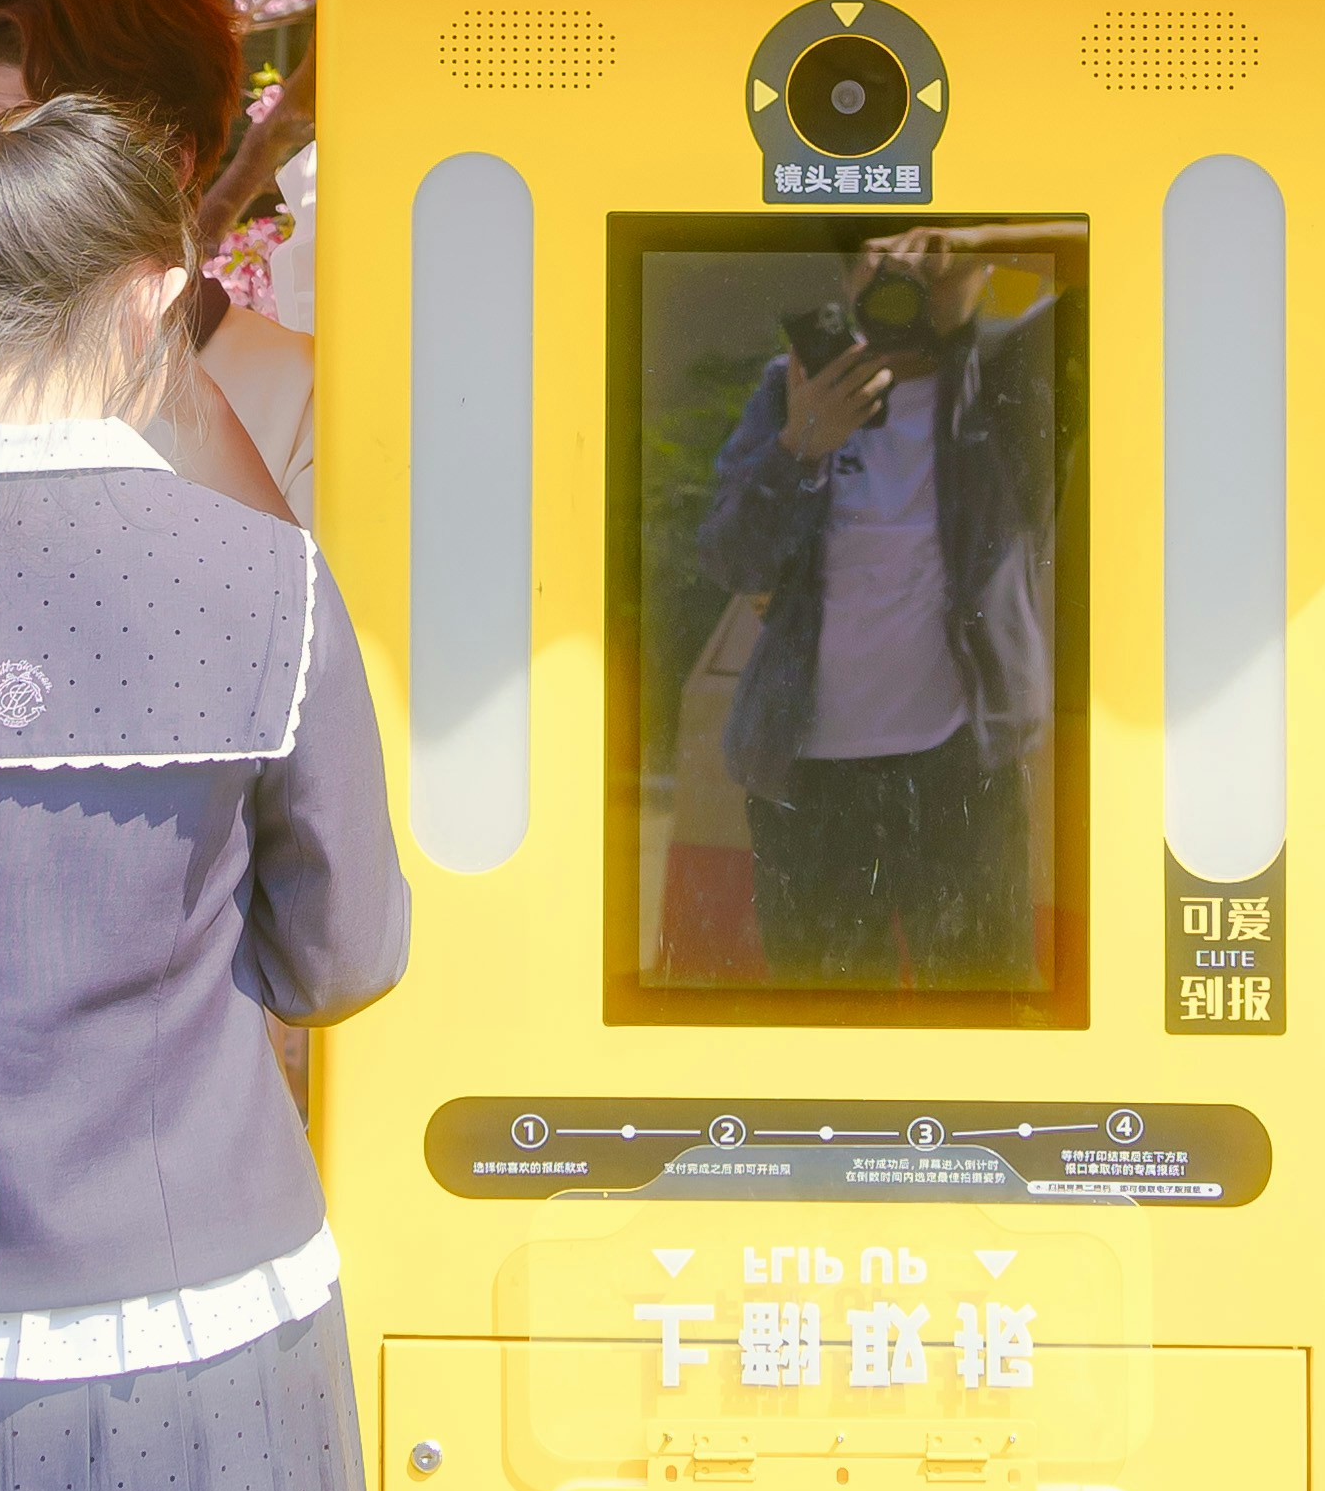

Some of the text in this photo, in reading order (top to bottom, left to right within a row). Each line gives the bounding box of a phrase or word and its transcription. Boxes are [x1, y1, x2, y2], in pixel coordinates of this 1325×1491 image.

[773, 163, 922, 194] 镜头看这里
[1179, 896, 1272, 942] 可爱
[1195, 949, 1256, 968] CUTE
[1179, 975, 1272, 1022] 到报
